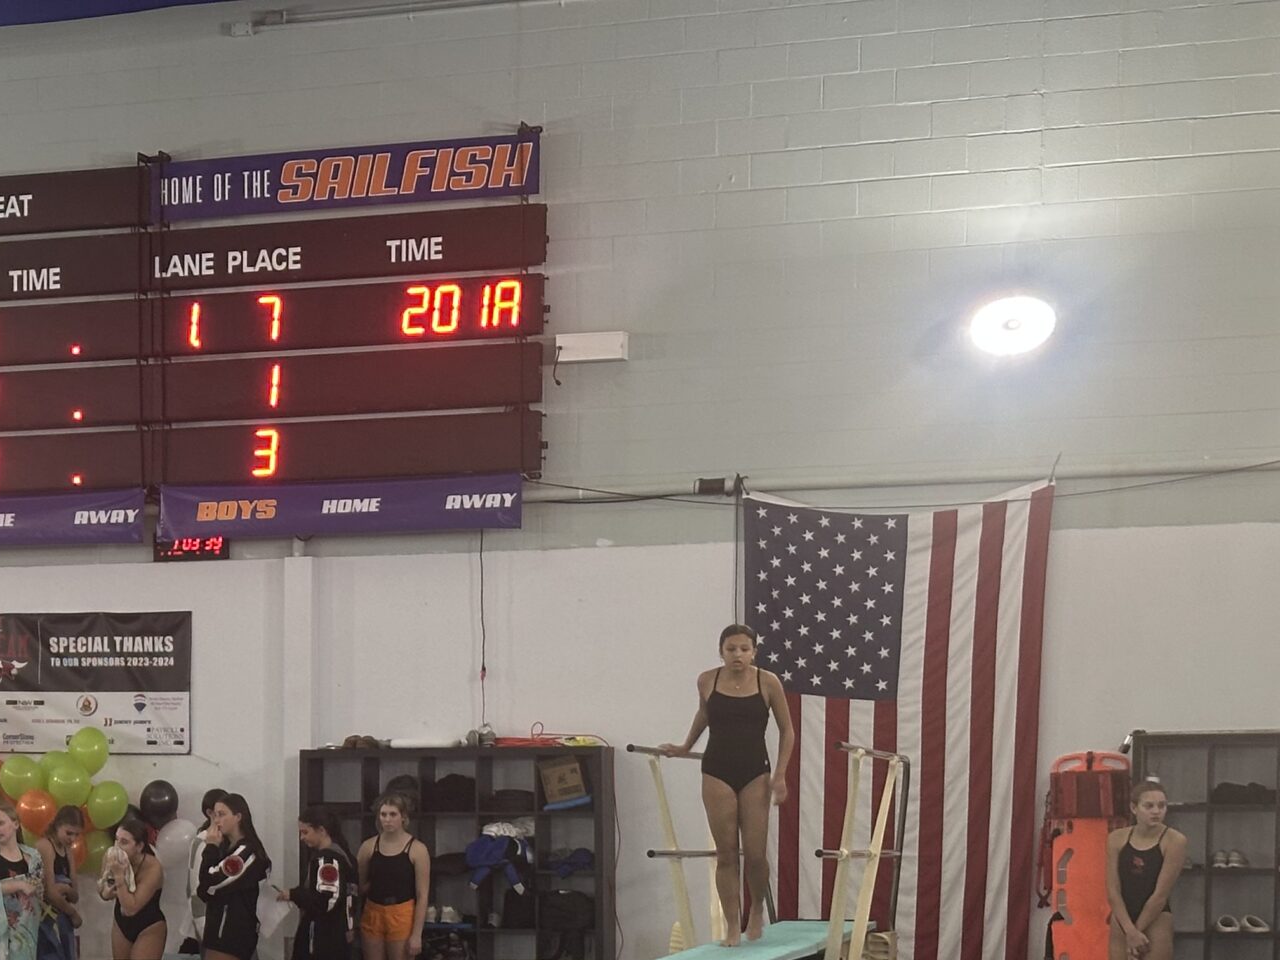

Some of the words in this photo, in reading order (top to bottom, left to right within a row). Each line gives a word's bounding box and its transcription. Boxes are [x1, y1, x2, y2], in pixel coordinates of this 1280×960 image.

[161, 175, 203, 205] HOME
[214, 173, 232, 201] OF
[243, 170, 271, 199] THE
[277, 142, 533, 203] SAILFISH
[155, 252, 214, 278] LANE
[227, 247, 302, 274] PLACE
[386, 236, 443, 263] TIME
[8, 267, 61, 292] TIME
[258, 296, 282, 341] 7
[269, 364, 281, 408] 1
[251, 429, 279, 477] 3
[74, 509, 139, 525] AWAY
[196, 499, 278, 522] BOYS
[321, 497, 381, 514] HOME
[445, 493, 517, 510] AWAY
[49, 636, 110, 653] SPECIAL
[114, 635, 174, 653] THANKS
[50, 657, 60, 667] TO
[62, 657, 79, 667] OUR
[81, 657, 125, 667] SPONSORS
[126, 657, 174, 667] 2023-2024
